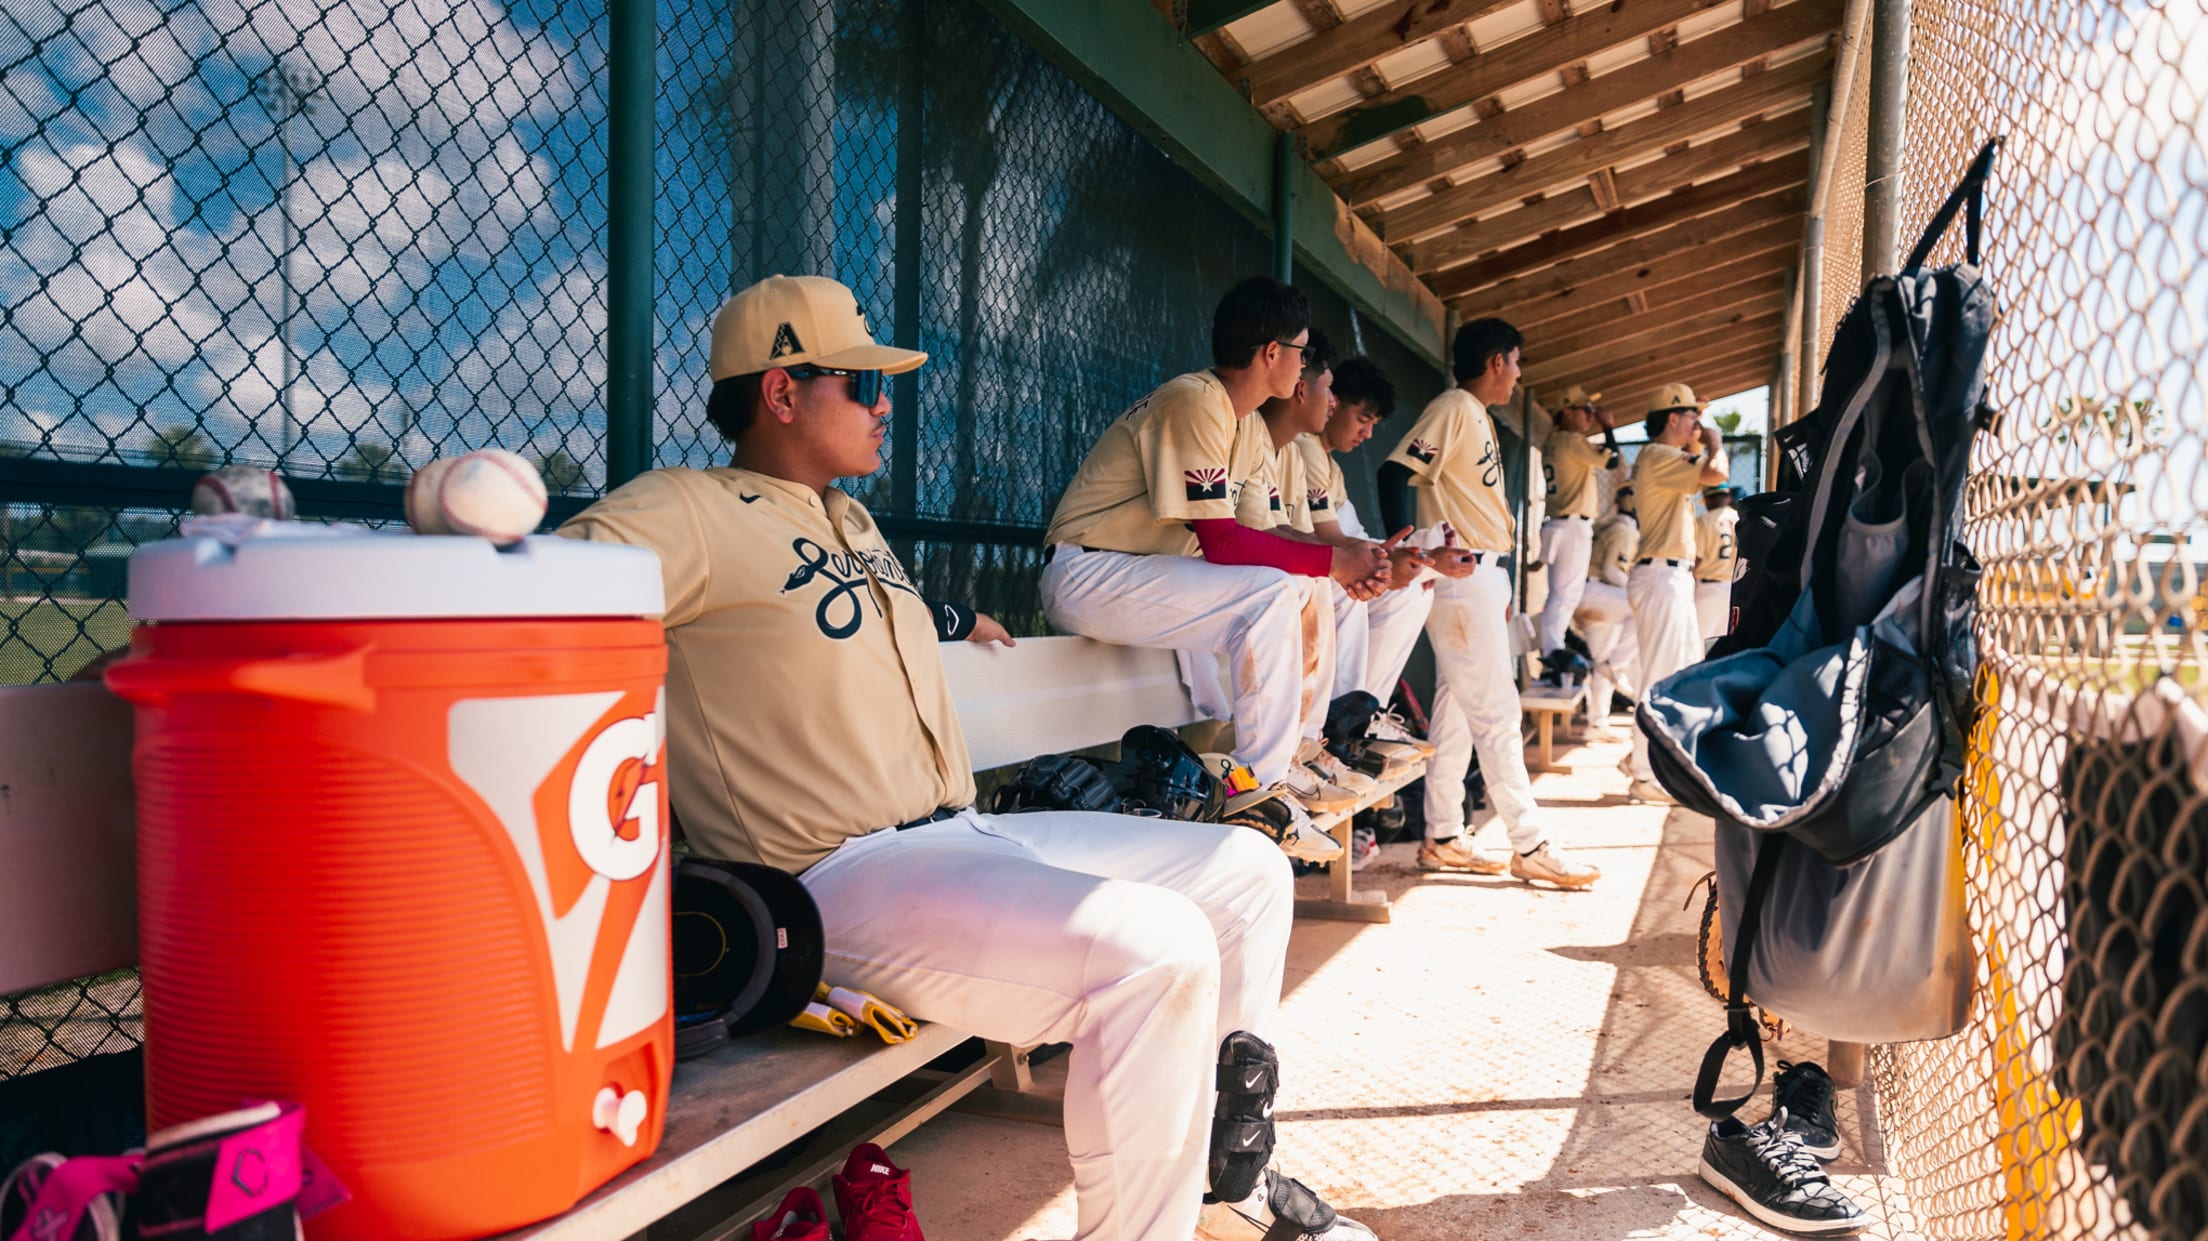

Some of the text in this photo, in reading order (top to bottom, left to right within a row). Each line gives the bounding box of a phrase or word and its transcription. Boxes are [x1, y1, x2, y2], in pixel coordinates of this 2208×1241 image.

[769, 321, 807, 361] A
[568, 712, 660, 882] G
[869, 1163, 891, 1176] NIKE
